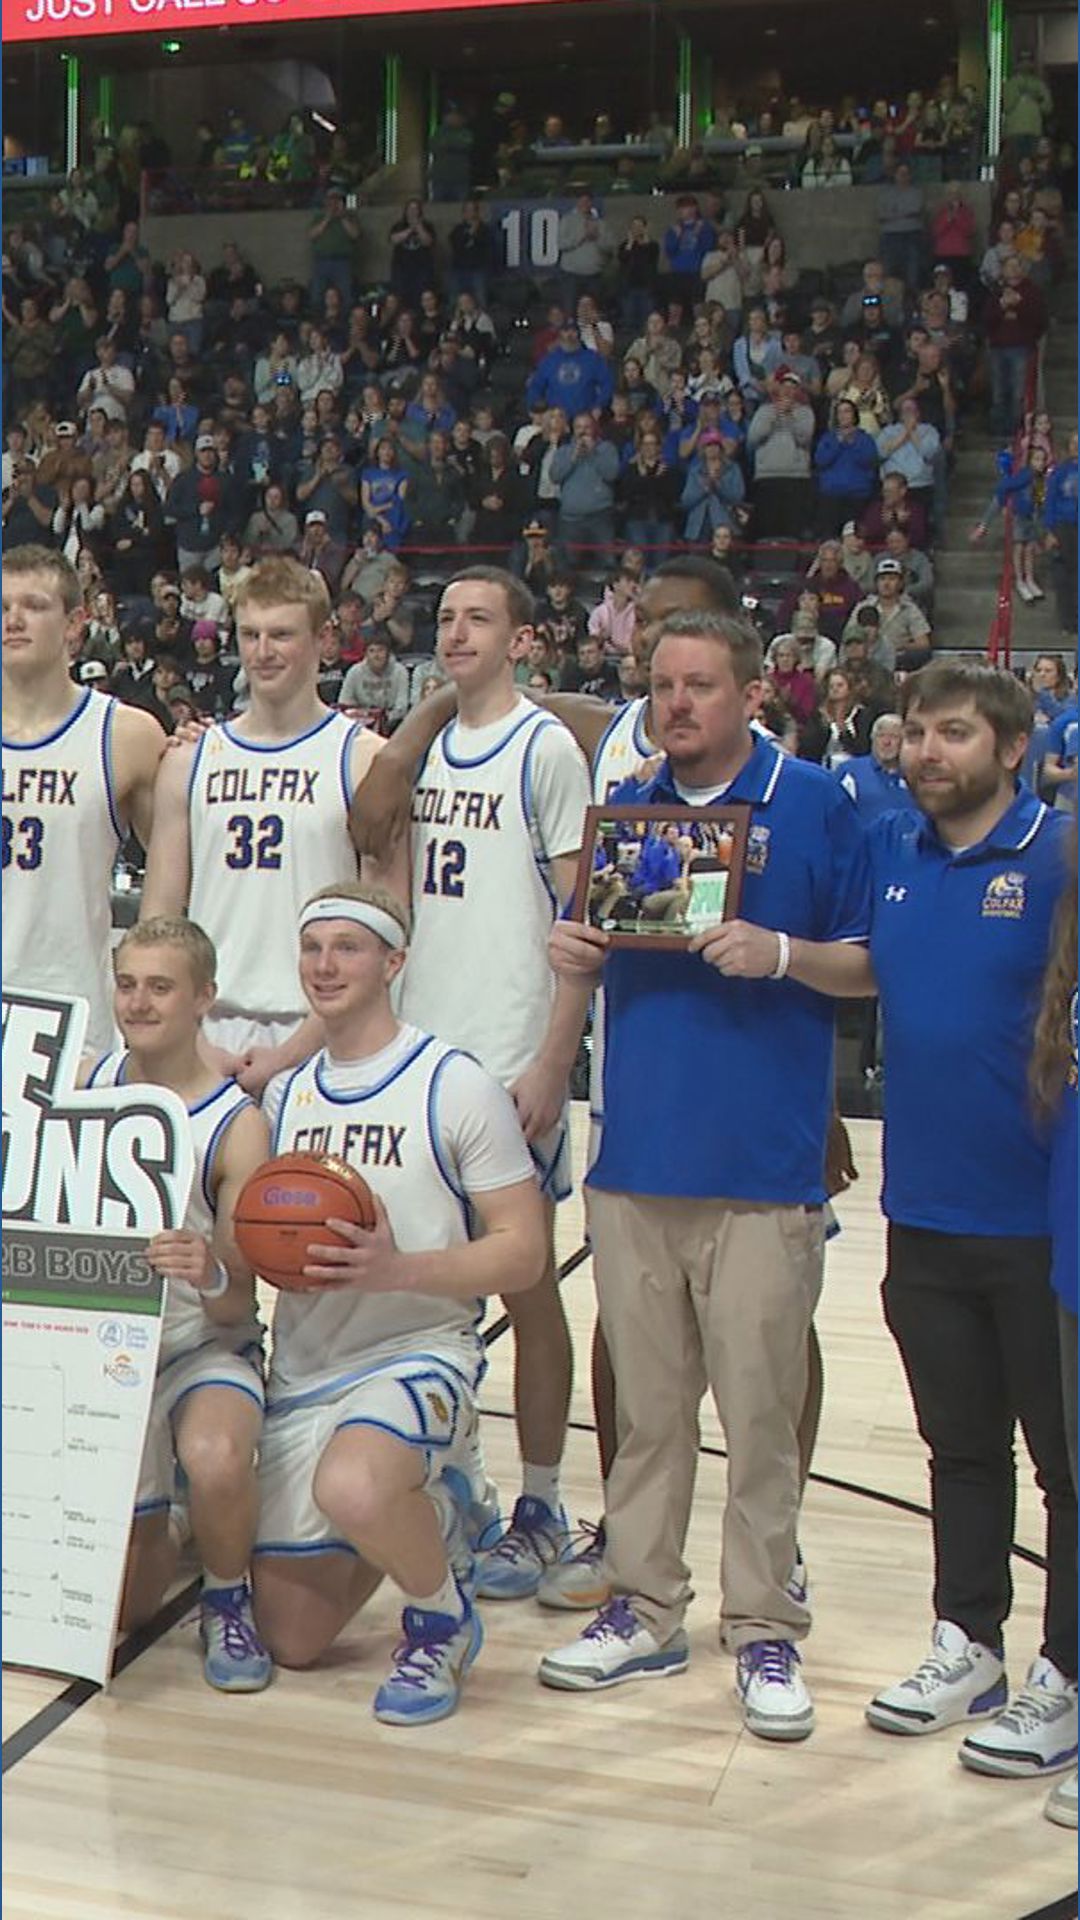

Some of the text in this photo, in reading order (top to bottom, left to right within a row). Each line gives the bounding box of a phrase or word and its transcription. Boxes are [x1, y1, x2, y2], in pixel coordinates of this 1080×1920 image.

[502, 210, 559, 267] 10
[206, 768, 319, 805] COLFAX
[410, 788, 504, 830] COLFAX
[225, 814, 284, 870] 32
[423, 838, 467, 898] 12
[45, 1246, 152, 1286] BOYS
